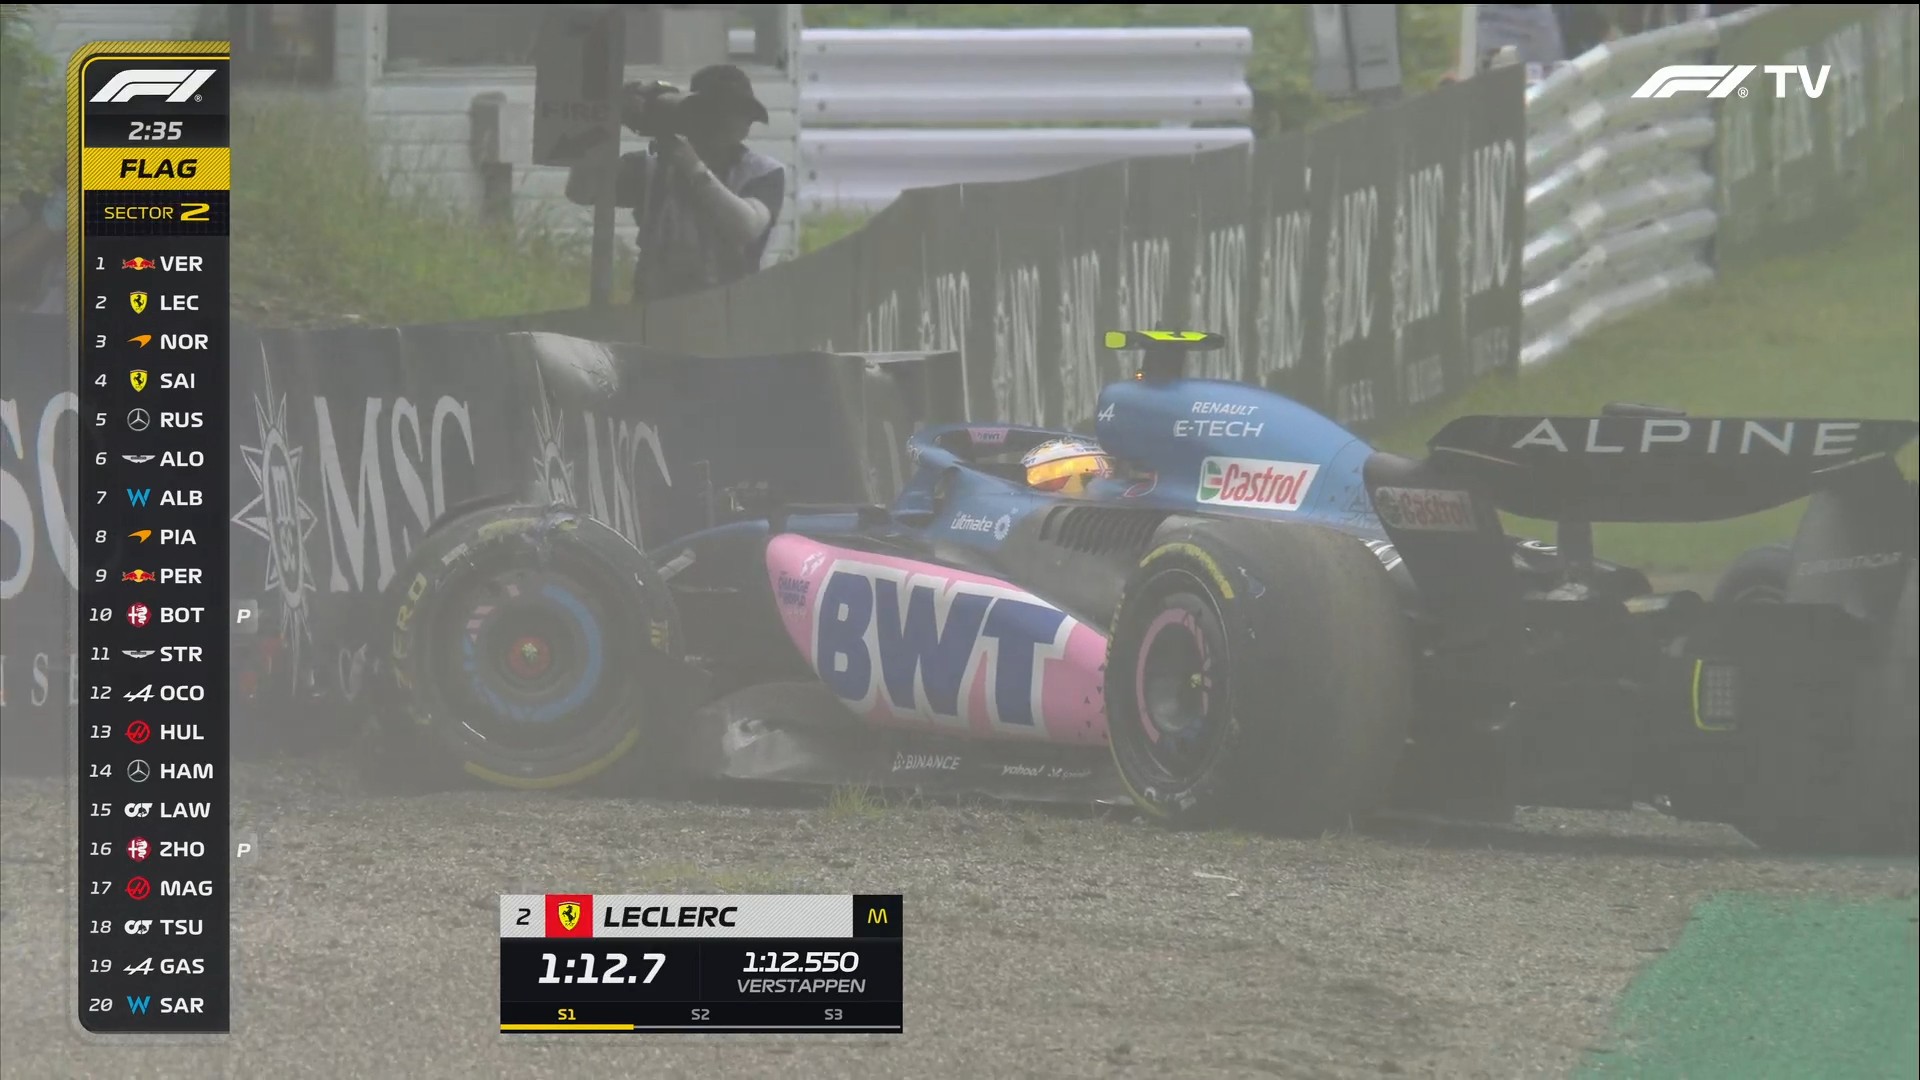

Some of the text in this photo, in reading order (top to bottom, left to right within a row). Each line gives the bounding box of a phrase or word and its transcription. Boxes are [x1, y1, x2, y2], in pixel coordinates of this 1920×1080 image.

[1191, 401, 1259, 416] RENAULT
[1173, 419, 1264, 438] E-TECH
[1512, 418, 1861, 456] ALPINE
[1220, 463, 1308, 504] Castrol
[1400, 491, 1470, 525] Castrol
[951, 512, 994, 532] ultimate
[817, 570, 1071, 728] BWT
[905, 754, 961, 770] BINANCE
[1001, 764, 1045, 776] yahoo!
